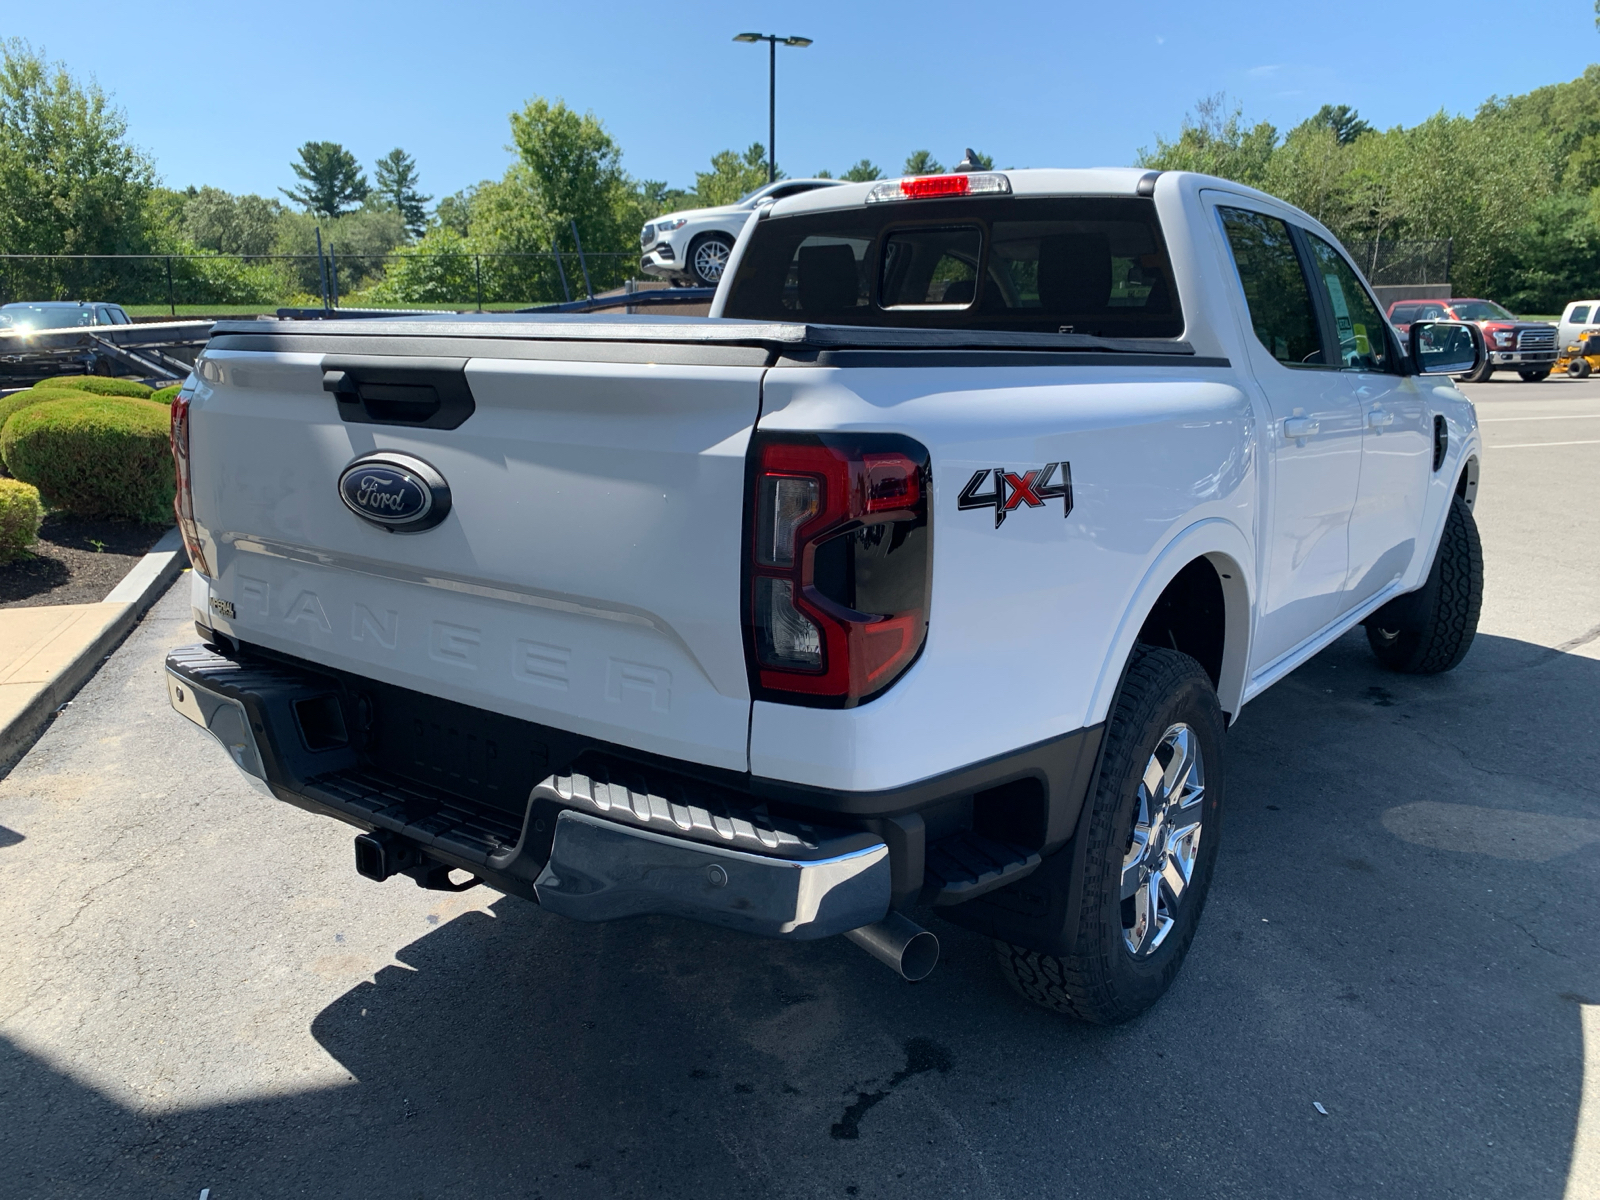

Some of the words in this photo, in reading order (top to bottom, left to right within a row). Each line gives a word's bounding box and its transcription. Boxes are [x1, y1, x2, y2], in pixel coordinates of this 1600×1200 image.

[357, 475, 405, 511] Ford
[209, 597, 234, 611] MPERIAL
[235, 573, 673, 715] RANGER
